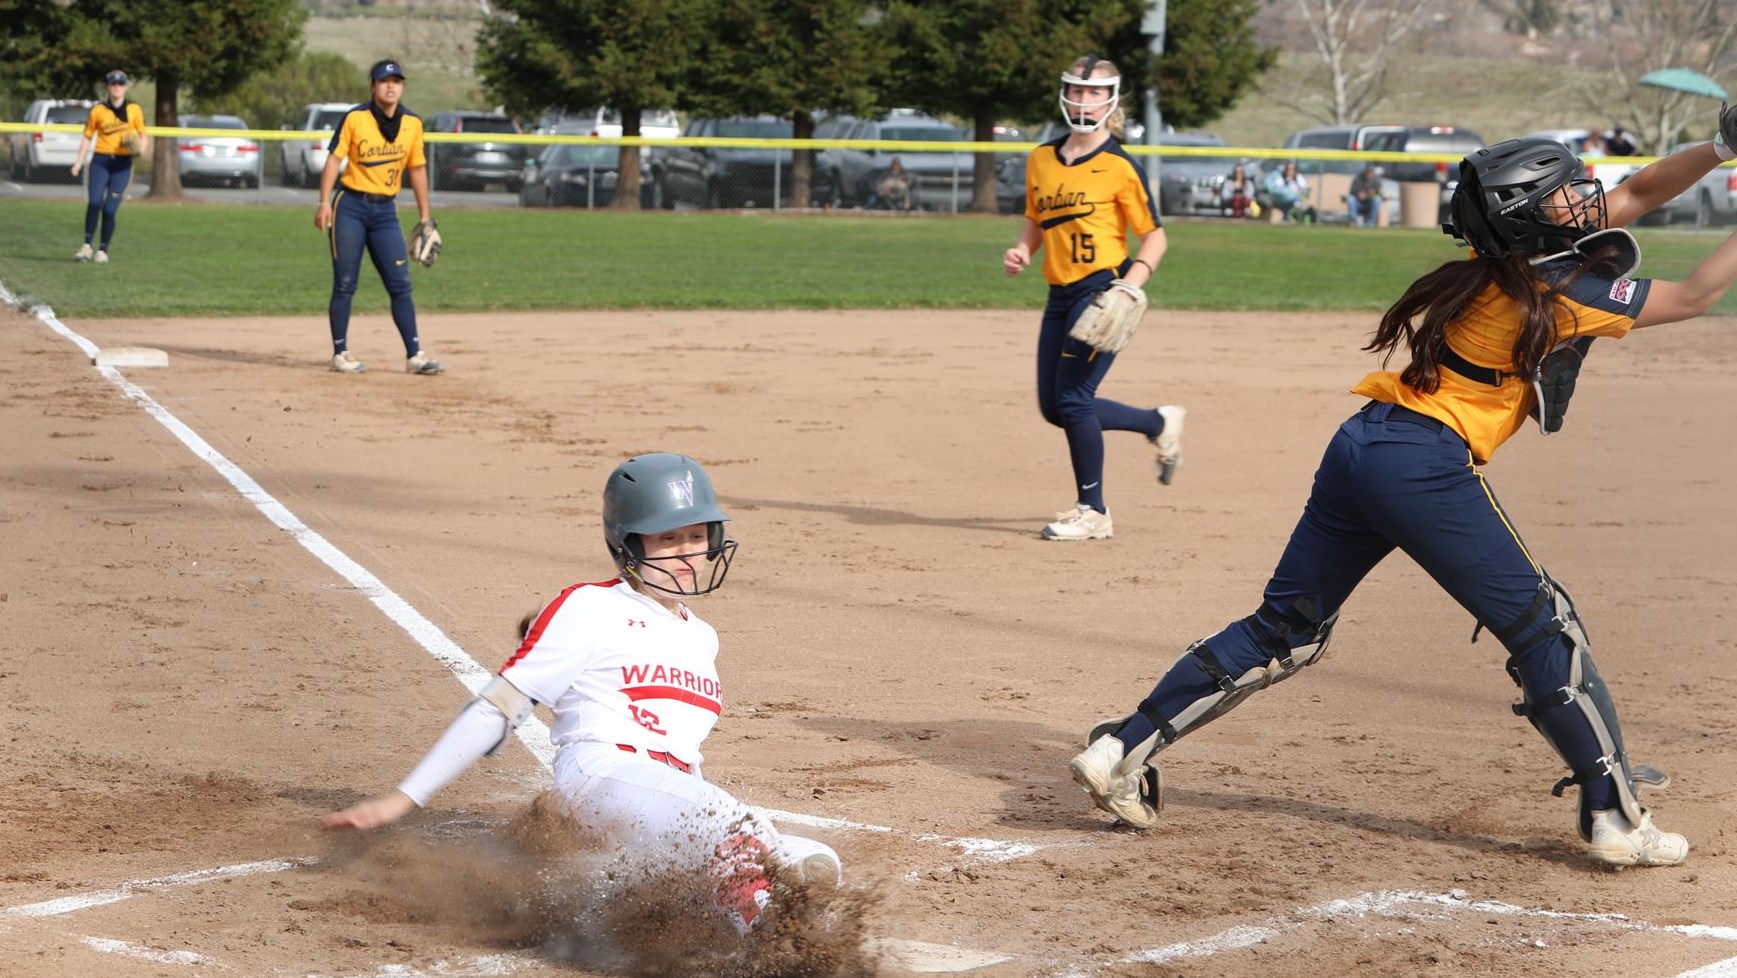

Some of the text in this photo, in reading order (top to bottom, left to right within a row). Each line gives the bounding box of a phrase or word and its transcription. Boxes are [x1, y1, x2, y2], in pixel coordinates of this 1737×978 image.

[357, 138, 405, 157] Corban
[1500, 198, 1529, 215] EASTON
[1070, 232, 1095, 264] 15
[628, 704, 667, 736] 12
